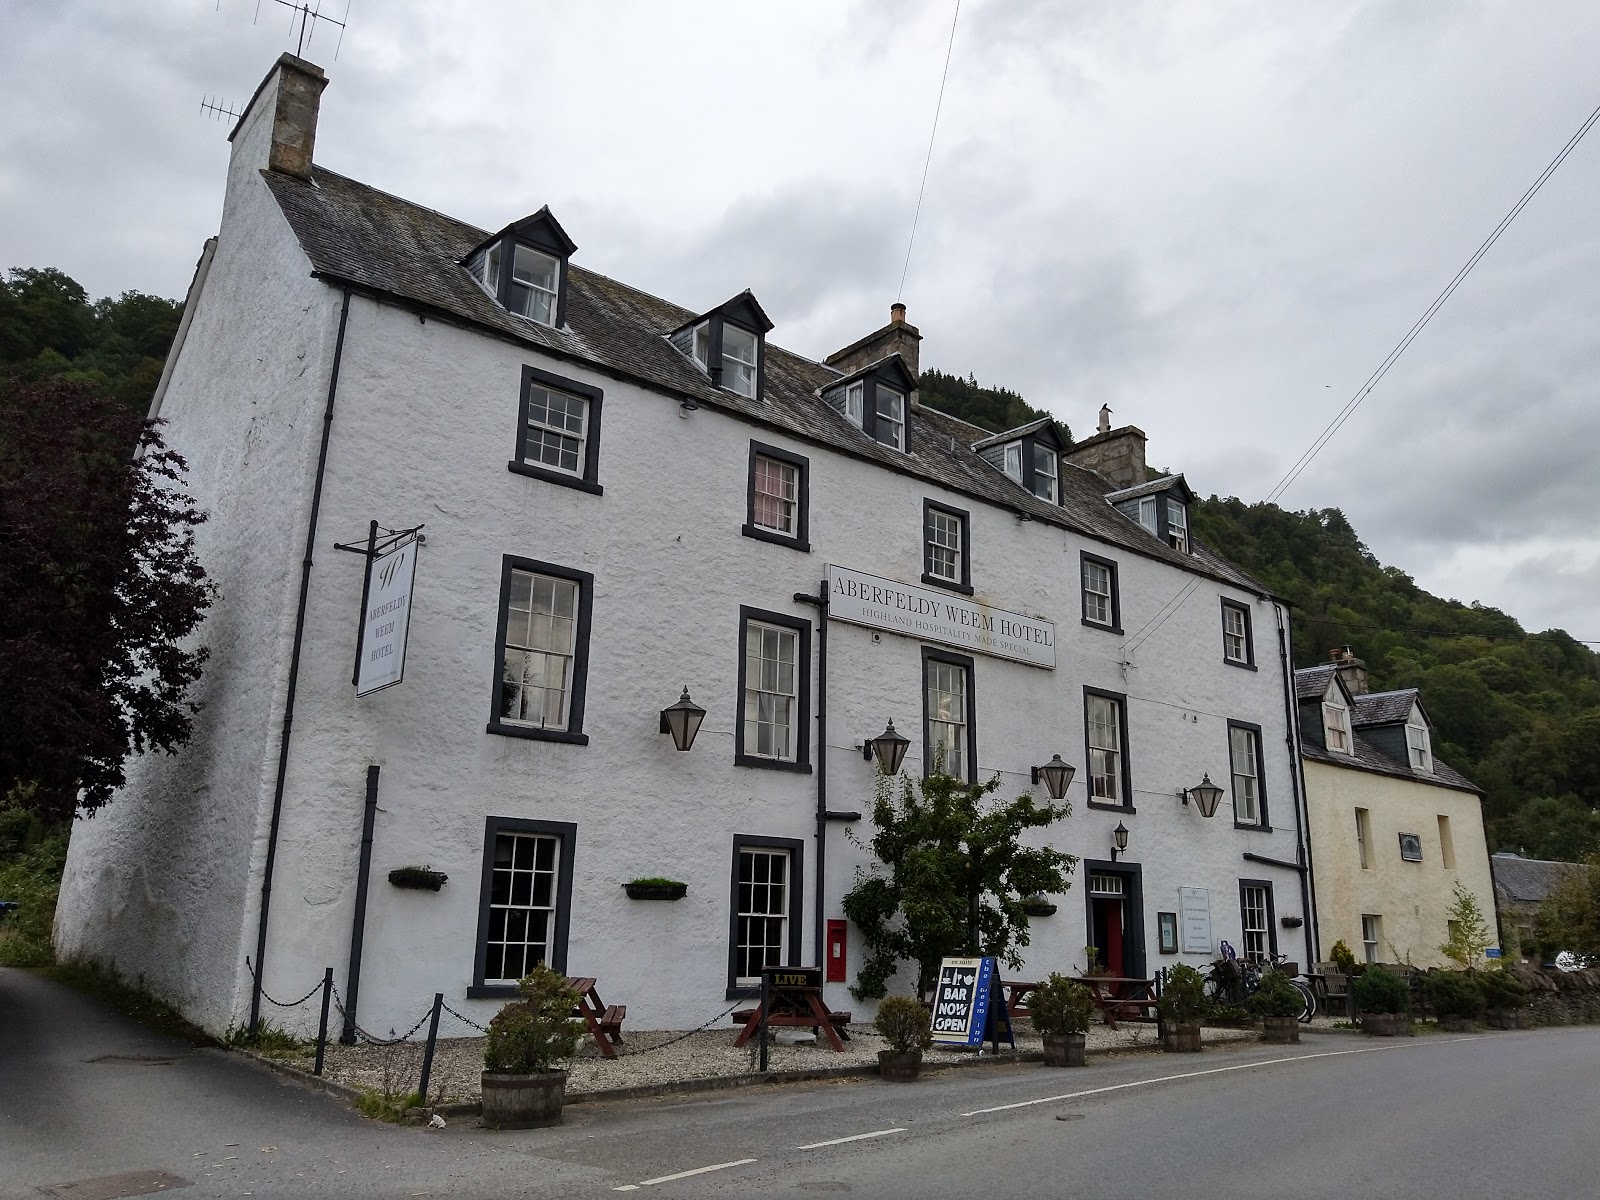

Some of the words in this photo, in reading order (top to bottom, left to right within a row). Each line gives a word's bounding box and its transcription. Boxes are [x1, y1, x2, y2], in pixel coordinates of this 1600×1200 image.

[370, 594, 408, 621] ABERFELDY
[833, 577, 940, 619] ABERFELDY
[945, 604, 995, 633] WEEM
[1000, 619, 1053, 647] HOTEL
[375, 621, 395, 639] WEEM
[862, 607, 912, 627] HIGHLAND
[915, 620, 972, 641] HOSPITALITY
[974, 634, 998, 647] MADE
[1000, 640, 1031, 656] SPECIAL
[370, 643, 394, 662] HOTEL
[775, 974, 807, 985] LIVE
[943, 987, 967, 1001] BAR
[938, 1002, 969, 1016] NOW
[935, 1017, 967, 1031] OPEN
